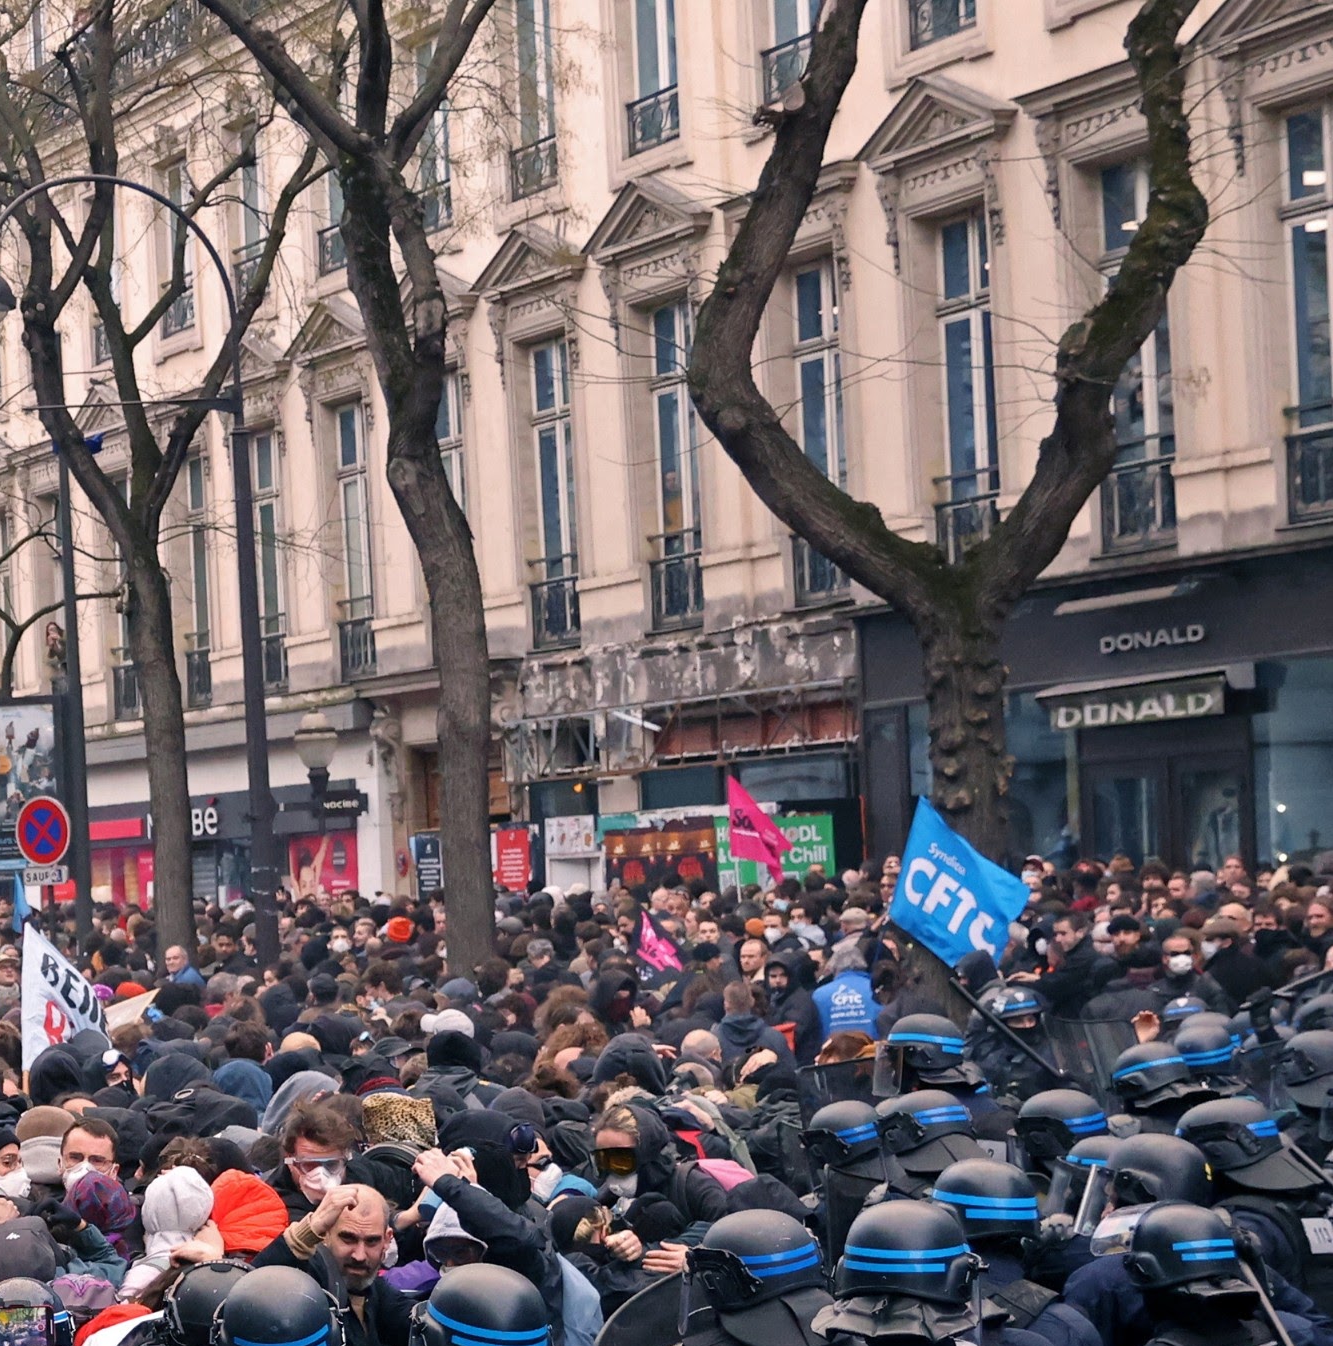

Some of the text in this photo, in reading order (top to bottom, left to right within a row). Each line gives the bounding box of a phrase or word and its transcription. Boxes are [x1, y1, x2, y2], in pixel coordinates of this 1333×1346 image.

[1099, 624, 1205, 654] DONALD
[1057, 692, 1214, 729] DONALD
[789, 843, 827, 864] Chill
[904, 857, 996, 956] CFTC
